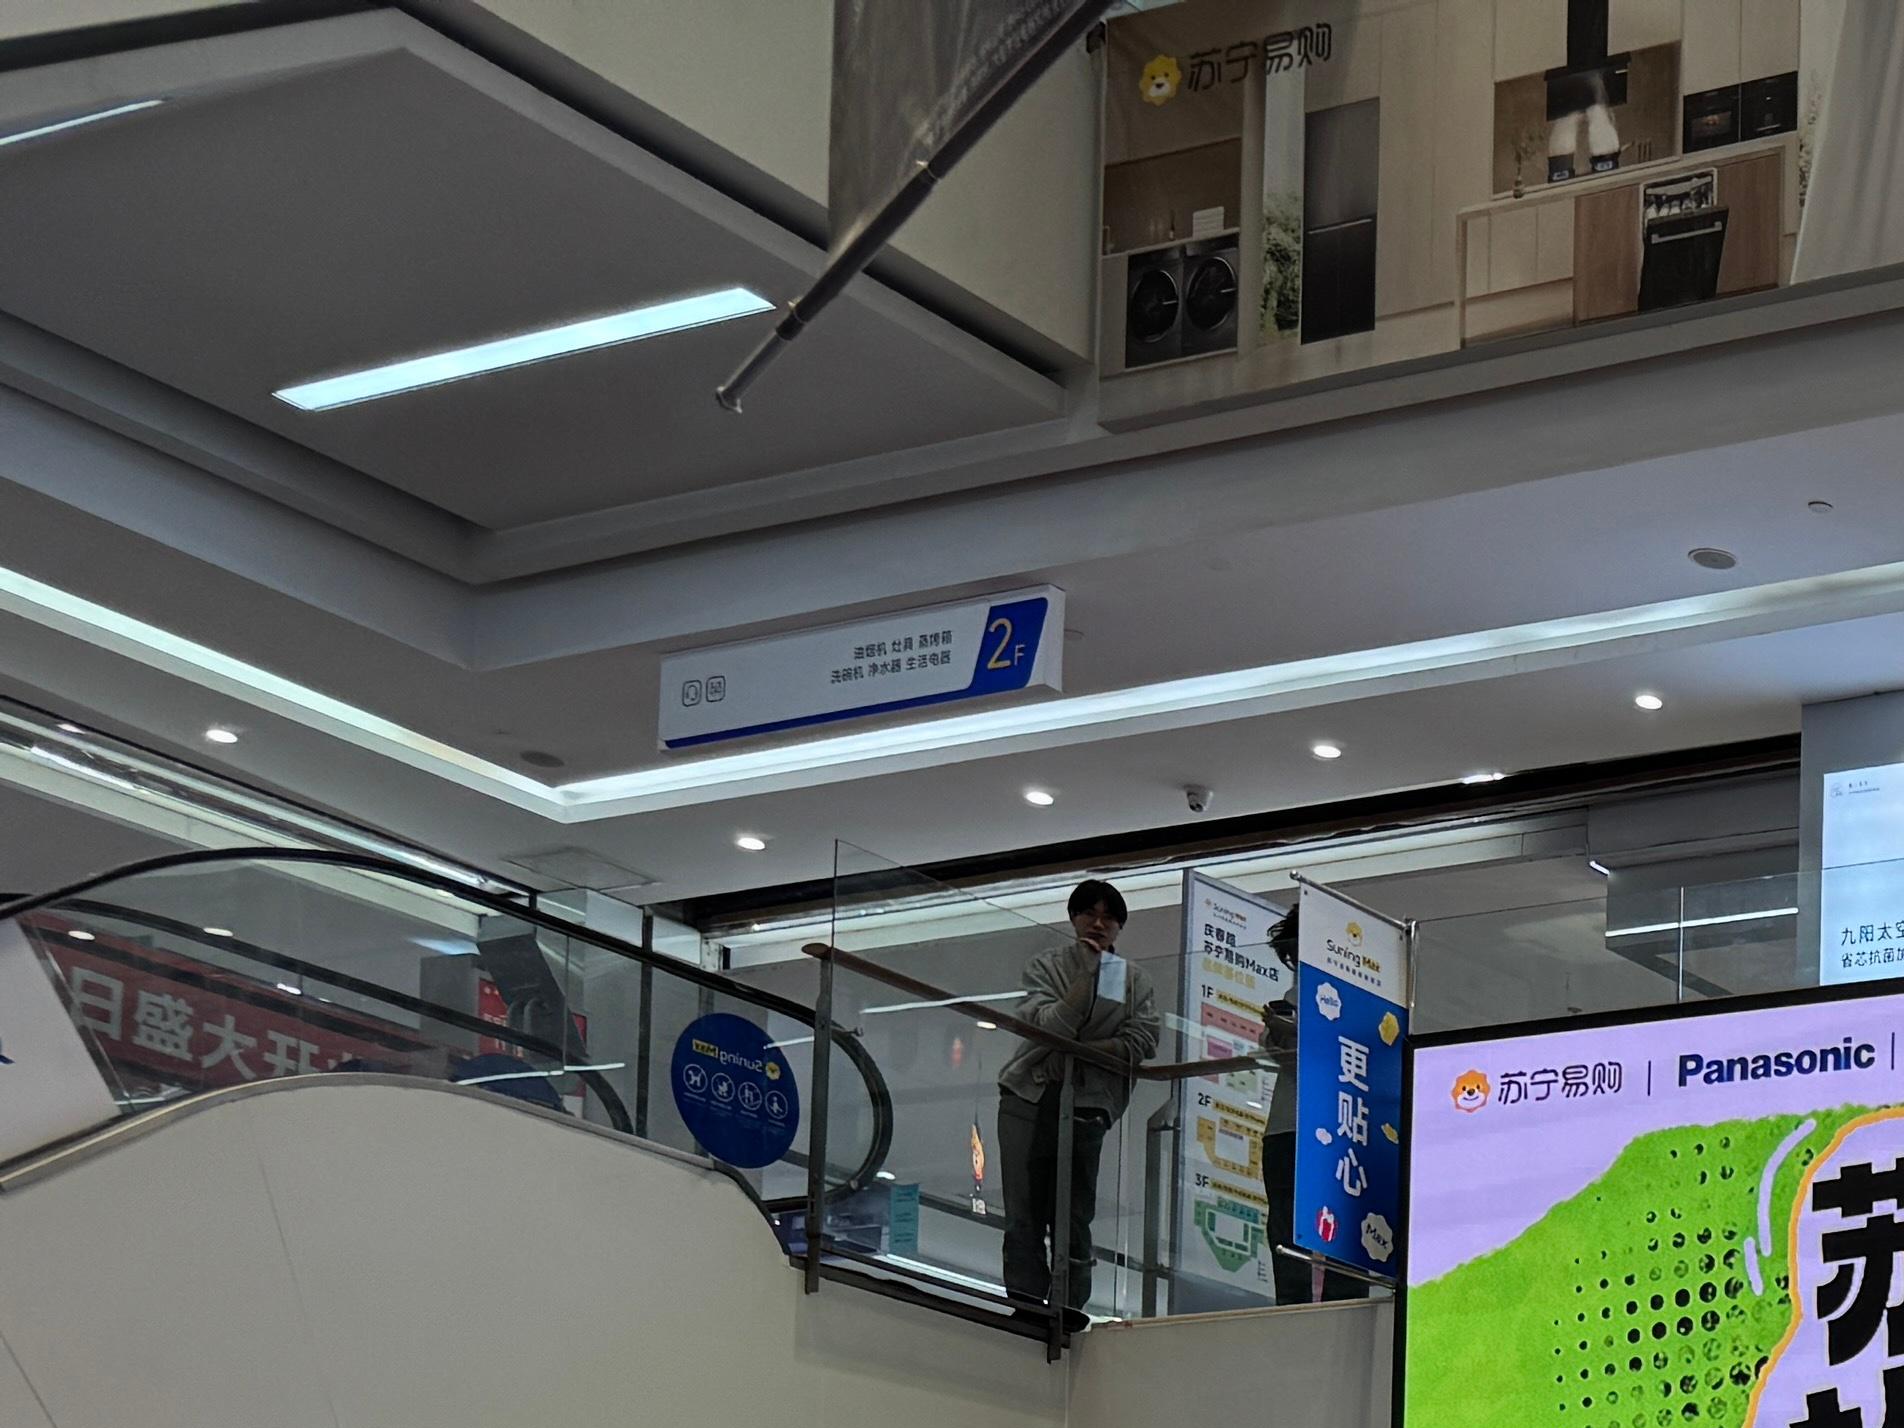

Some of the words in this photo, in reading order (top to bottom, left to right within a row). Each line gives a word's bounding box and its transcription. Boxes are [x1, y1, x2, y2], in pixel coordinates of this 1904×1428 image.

[1187, 22, 1333, 93] 苏宁易购
[986, 617, 1025, 671] 2F
[1497, 1062, 1623, 1107] 苏宁易购
[1677, 1036, 1876, 1089] Panasonic
[1336, 1035, 1371, 1198] 更贴心
